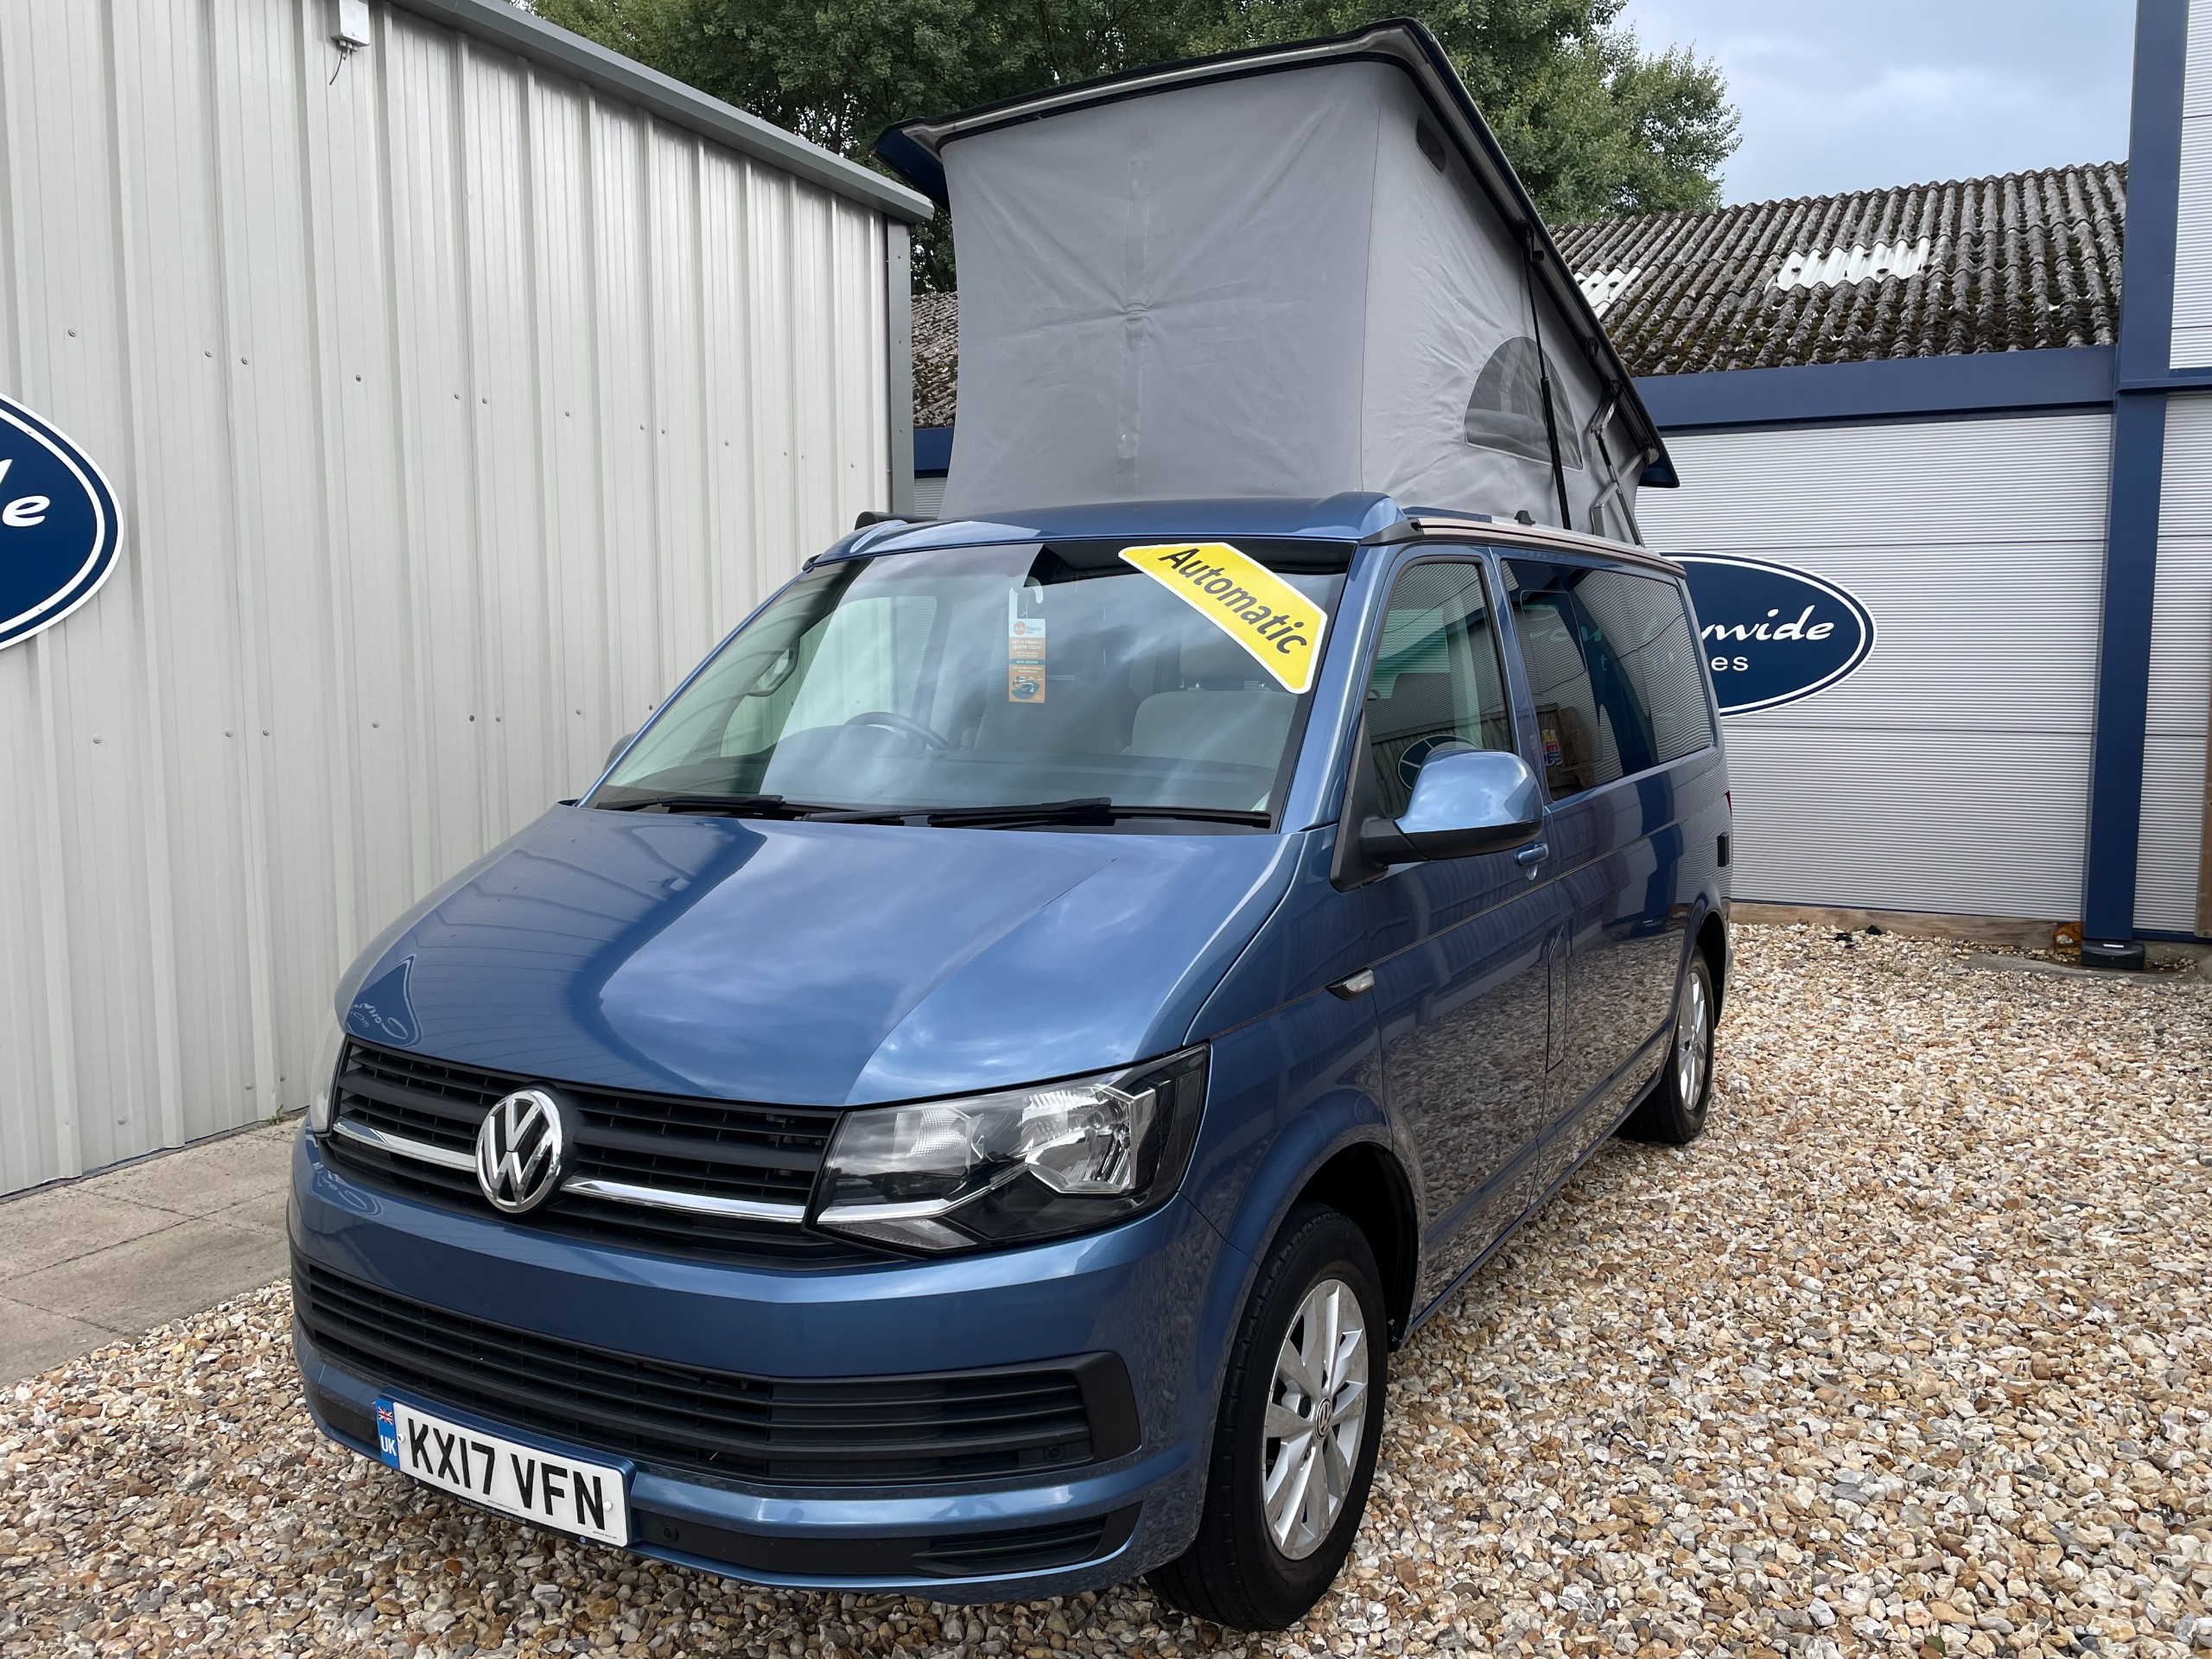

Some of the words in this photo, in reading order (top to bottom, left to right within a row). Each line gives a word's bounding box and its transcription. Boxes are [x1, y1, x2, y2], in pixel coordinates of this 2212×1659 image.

[1157, 547, 1308, 655] Automatic
[1710, 656, 1749, 671] es
[380, 1434, 397, 1457] UK
[407, 1417, 495, 1496] KX17
[510, 1453, 606, 1531] VFN
